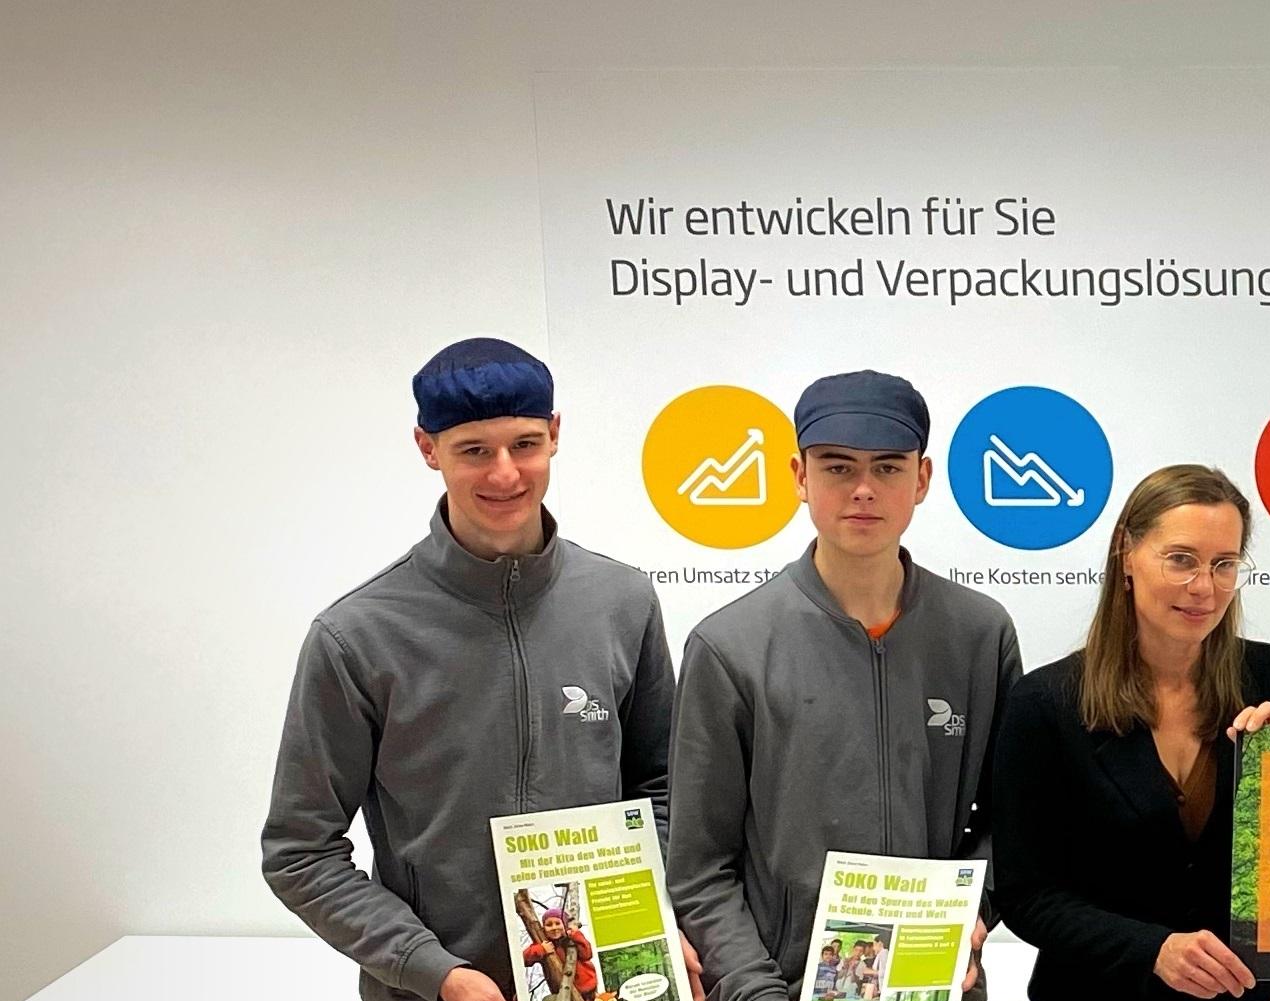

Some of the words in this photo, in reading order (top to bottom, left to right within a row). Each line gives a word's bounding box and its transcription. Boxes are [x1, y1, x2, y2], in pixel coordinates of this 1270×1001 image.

[607, 198, 674, 235] Wir
[684, 196, 911, 236] entwickeln
[921, 196, 983, 236] für
[995, 198, 1056, 236] Sie
[610, 258, 773, 306] Display-
[787, 260, 864, 298] und
[683, 567, 751, 584] Umsatz
[949, 567, 984, 585] Ihre
[988, 568, 1051, 585] Kosten
[586, 699, 600, 712] DS
[580, 707, 609, 722] Smith
[951, 714, 966, 727] DS
[505, 833, 550, 854] SOKO
[554, 825, 599, 848] Wald
[520, 857, 535, 870] Mit
[537, 855, 554, 867] der
[577, 850, 595, 862] den
[597, 846, 621, 859] Wald
[623, 842, 642, 855] und
[593, 855, 642, 872] entdecken
[834, 871, 878, 891] SOKO
[884, 875, 928, 893] Wald
[880, 896, 914, 909] Spuren
[915, 897, 932, 908] des
[905, 908, 923, 919] und
